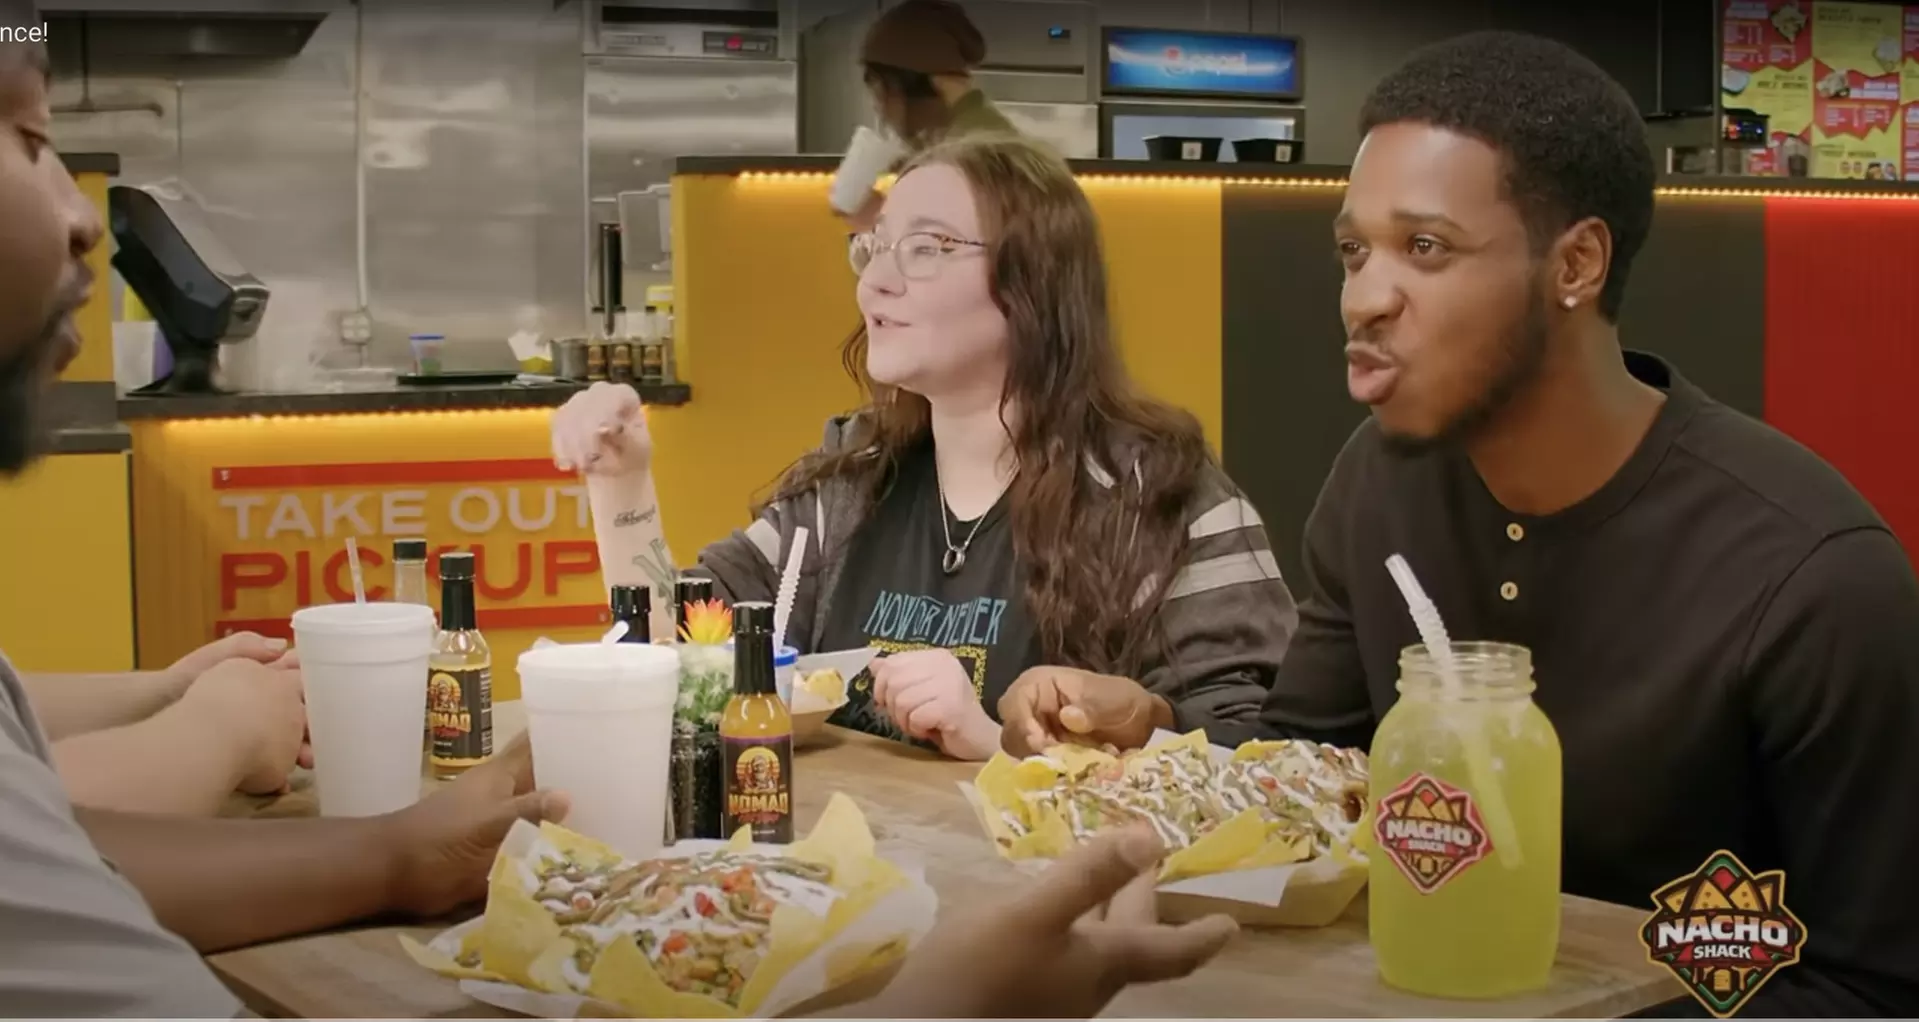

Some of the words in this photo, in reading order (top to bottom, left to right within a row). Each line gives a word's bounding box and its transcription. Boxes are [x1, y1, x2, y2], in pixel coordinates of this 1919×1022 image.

[219, 489, 429, 540] TAKE
[449, 486, 589, 532] OUT
[863, 589, 922, 641] NOW
[912, 602, 941, 637] OR
[932, 596, 1007, 646] NEVER
[728, 792, 789, 816] NOMAD
[1386, 820, 1472, 848] NACHO
